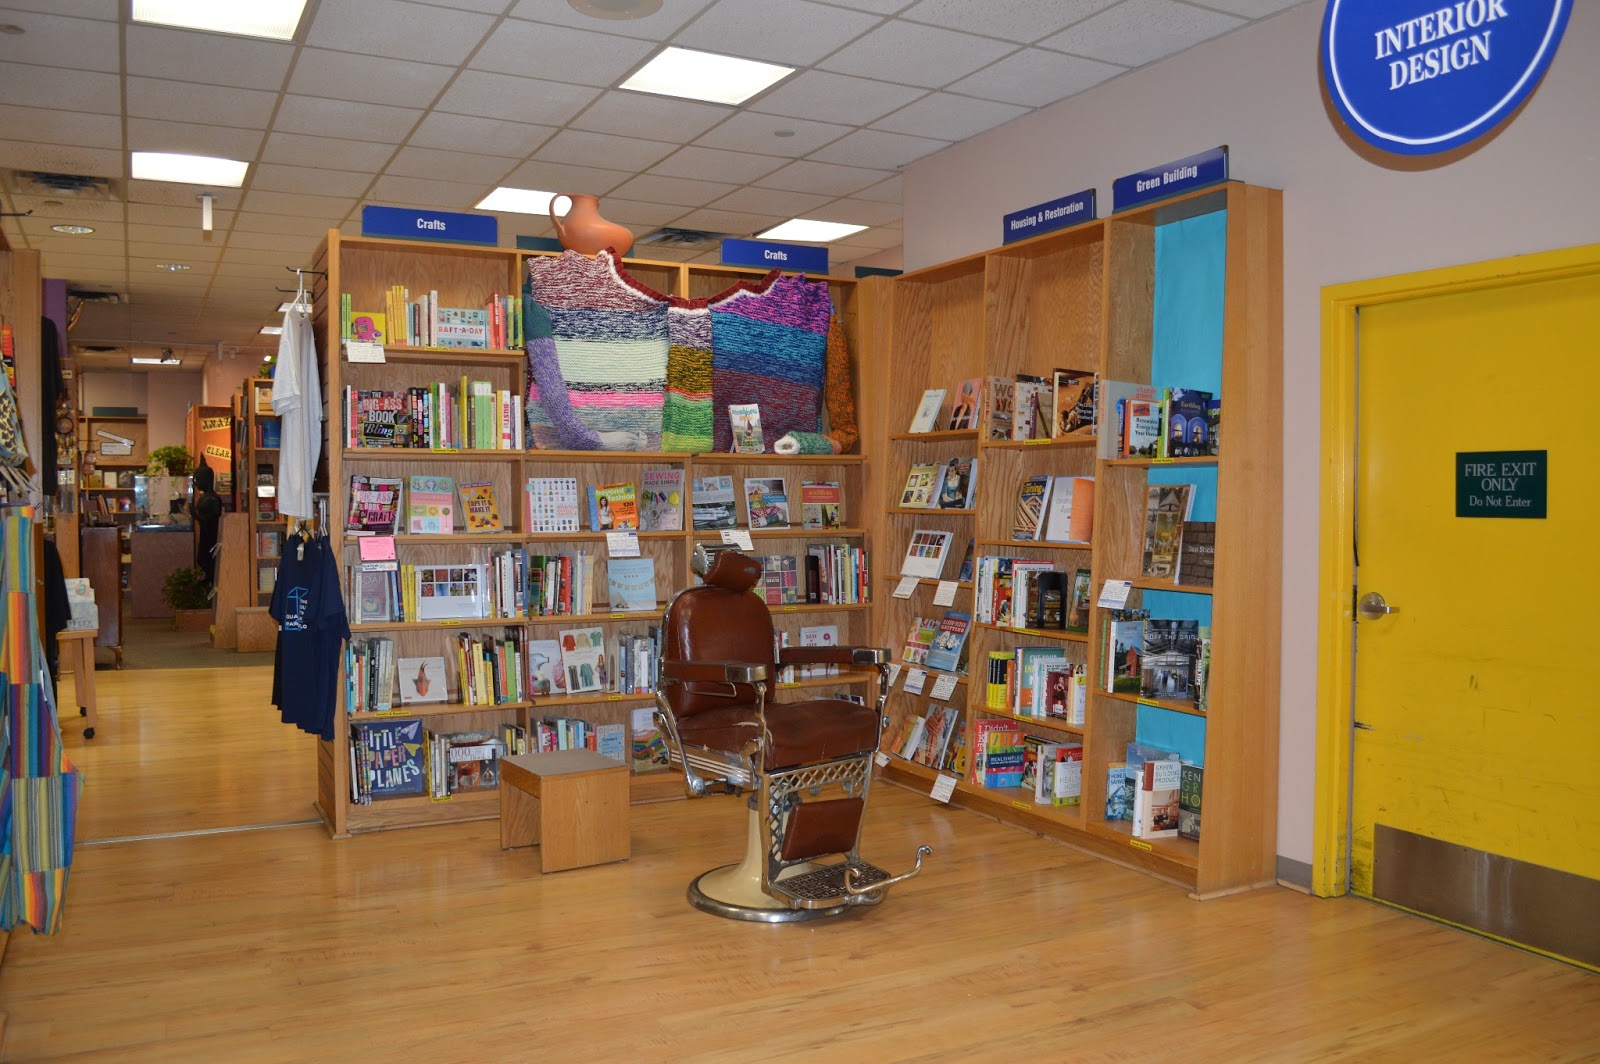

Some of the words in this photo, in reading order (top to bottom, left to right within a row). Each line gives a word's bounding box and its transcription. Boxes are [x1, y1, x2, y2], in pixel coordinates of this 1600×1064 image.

[1374, 0, 1508, 60] INTERIOR
[1388, 30, 1493, 91] DESIGN
[1136, 175, 1161, 193] Green
[1163, 165, 1198, 185] Building
[1010, 214, 1036, 231] Housing
[1037, 212, 1044, 223] &
[1044, 201, 1084, 221] Restoration
[416, 218, 446, 231] Crafts
[764, 249, 788, 261] Crafts
[438, 326, 483, 335] RAFT-A-DAY
[362, 398, 403, 411] BIG-ASS
[368, 410, 396, 424] BOOK
[366, 423, 395, 437] Bling
[206, 446, 230, 458] CLEAR
[1464, 463, 1497, 477] FIRE
[1501, 462, 1537, 476] EXIT
[644, 472, 680, 481] SEWING
[1481, 477, 1519, 491] ONLY
[595, 487, 624, 496] beyond
[607, 493, 635, 502] fashion
[1469, 495, 1483, 507] Do
[1485, 495, 1502, 507] Not
[1505, 495, 1532, 507] Enter
[368, 511, 396, 522] CRAFTS
[363, 575, 383, 585] OAP
[369, 726, 402, 751] ITTLE
[367, 745, 406, 769] PAPER
[450, 747, 471, 758] 000
[369, 758, 420, 788] PLANES
[1182, 769, 1201, 782] KEN
[1181, 792, 1201, 807] HO
